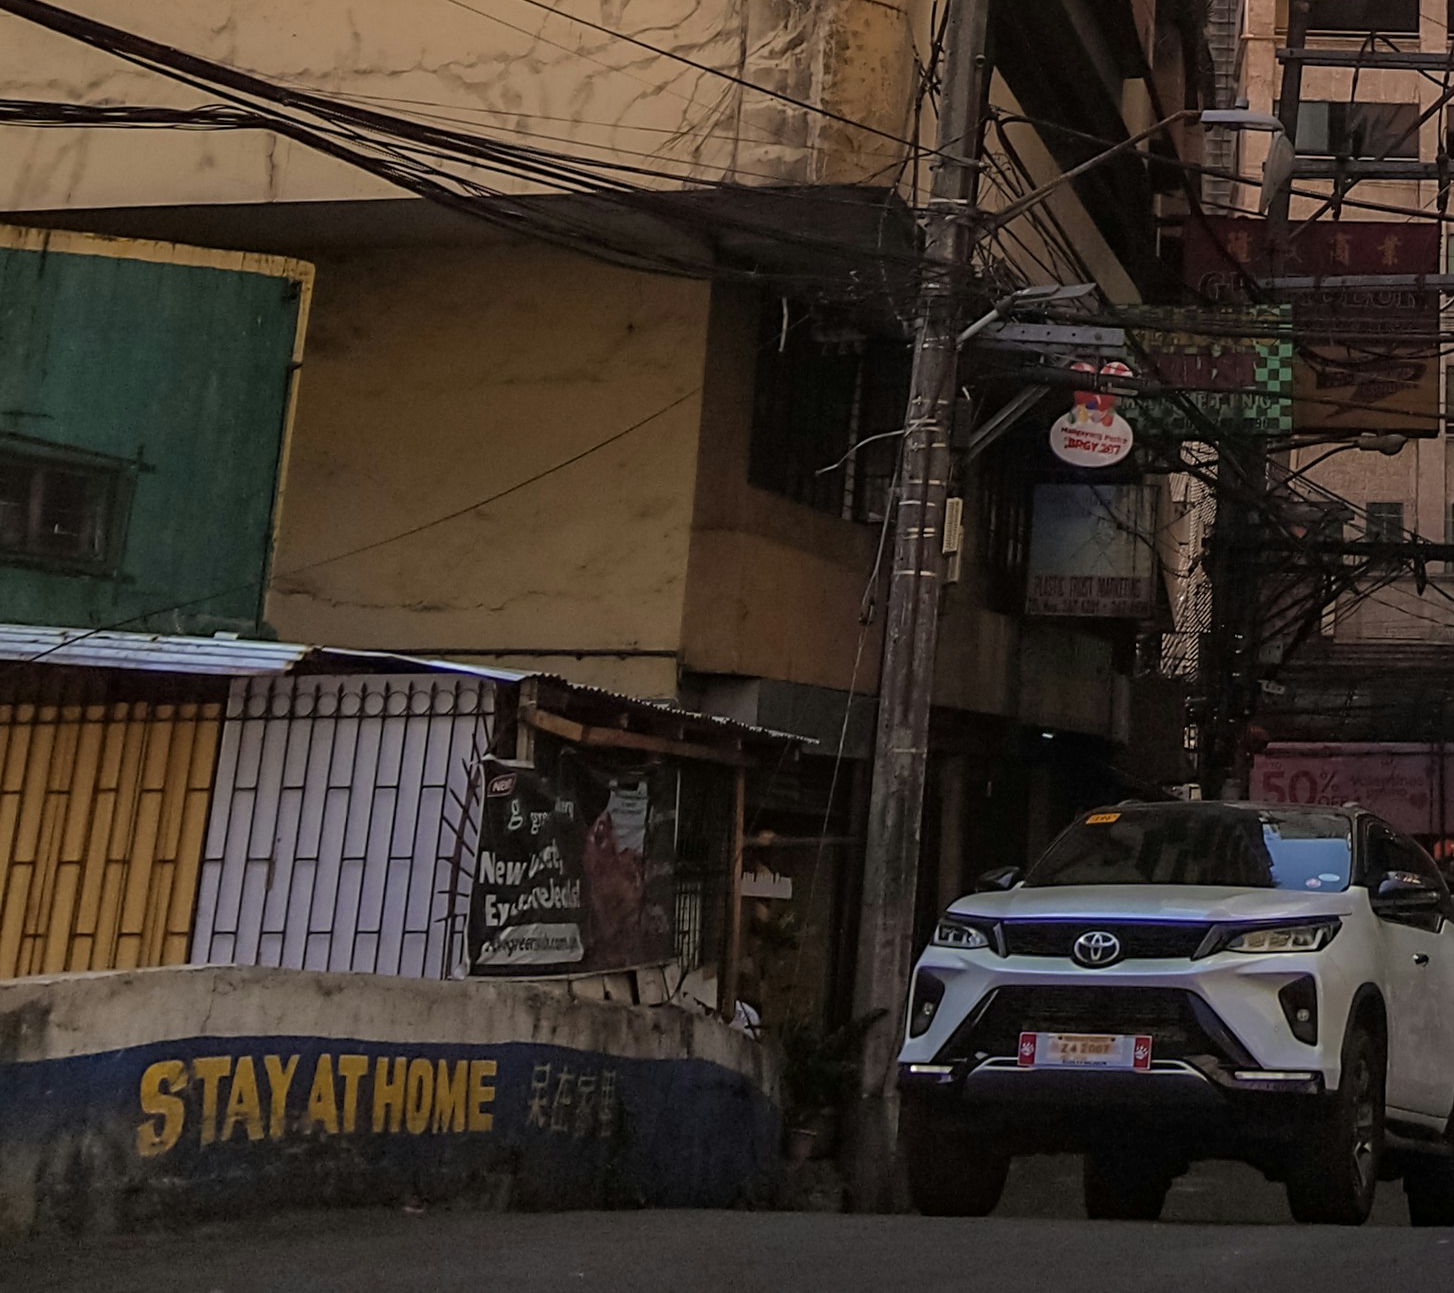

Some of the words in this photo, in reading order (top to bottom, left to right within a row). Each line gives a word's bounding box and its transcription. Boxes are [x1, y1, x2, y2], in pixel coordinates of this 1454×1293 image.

[1262, 769, 1338, 803] 50%
[478, 850, 528, 886] New
[137, 1054, 302, 1156] STAY
[306, 1053, 370, 1136] AT
[372, 1056, 498, 1136] HOME
